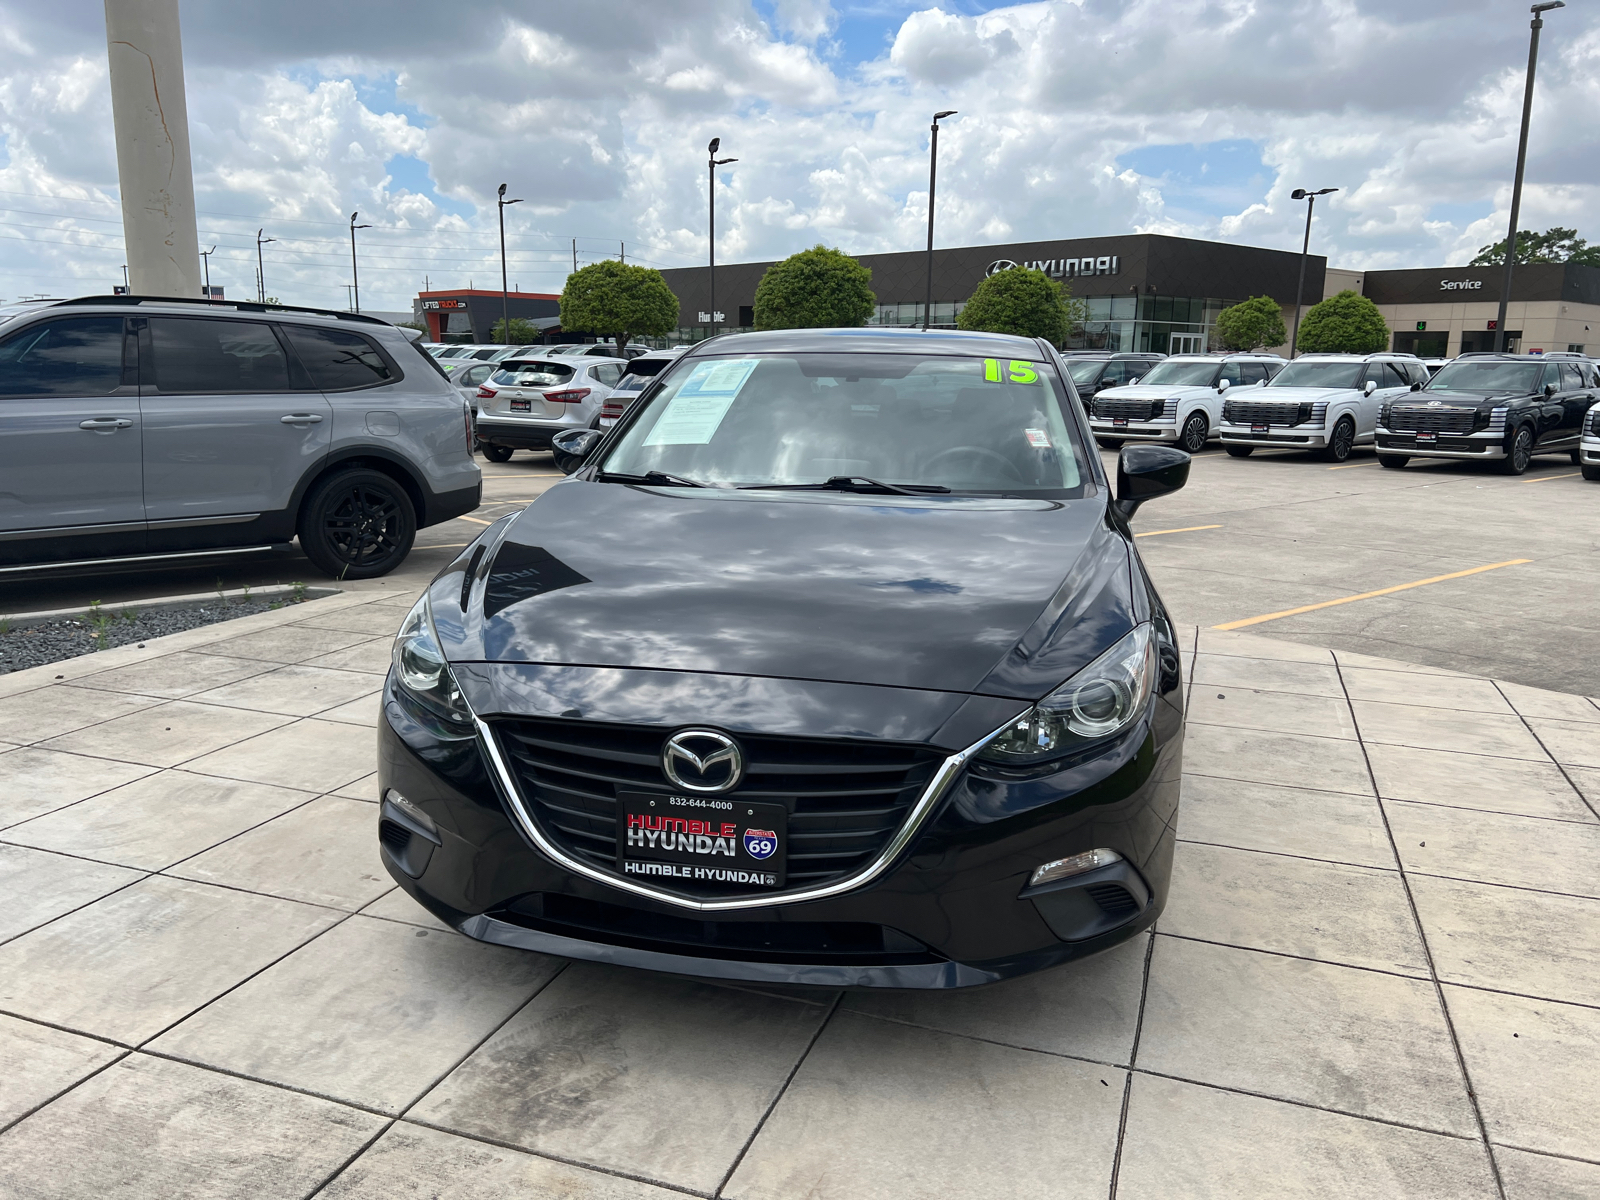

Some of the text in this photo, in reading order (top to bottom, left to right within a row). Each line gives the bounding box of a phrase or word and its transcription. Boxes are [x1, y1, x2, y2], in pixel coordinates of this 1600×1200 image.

[1440, 279, 1482, 290] Service
[983, 358, 1039, 384] 15
[669, 797, 733, 810] 832-644-4000
[627, 814, 737, 837] HUMBLE
[627, 828, 736, 857] HYUNDAI
[749, 840, 772, 854] 69
[624, 862, 692, 878] HUMBLE
[694, 867, 764, 885] HYUNDAI
